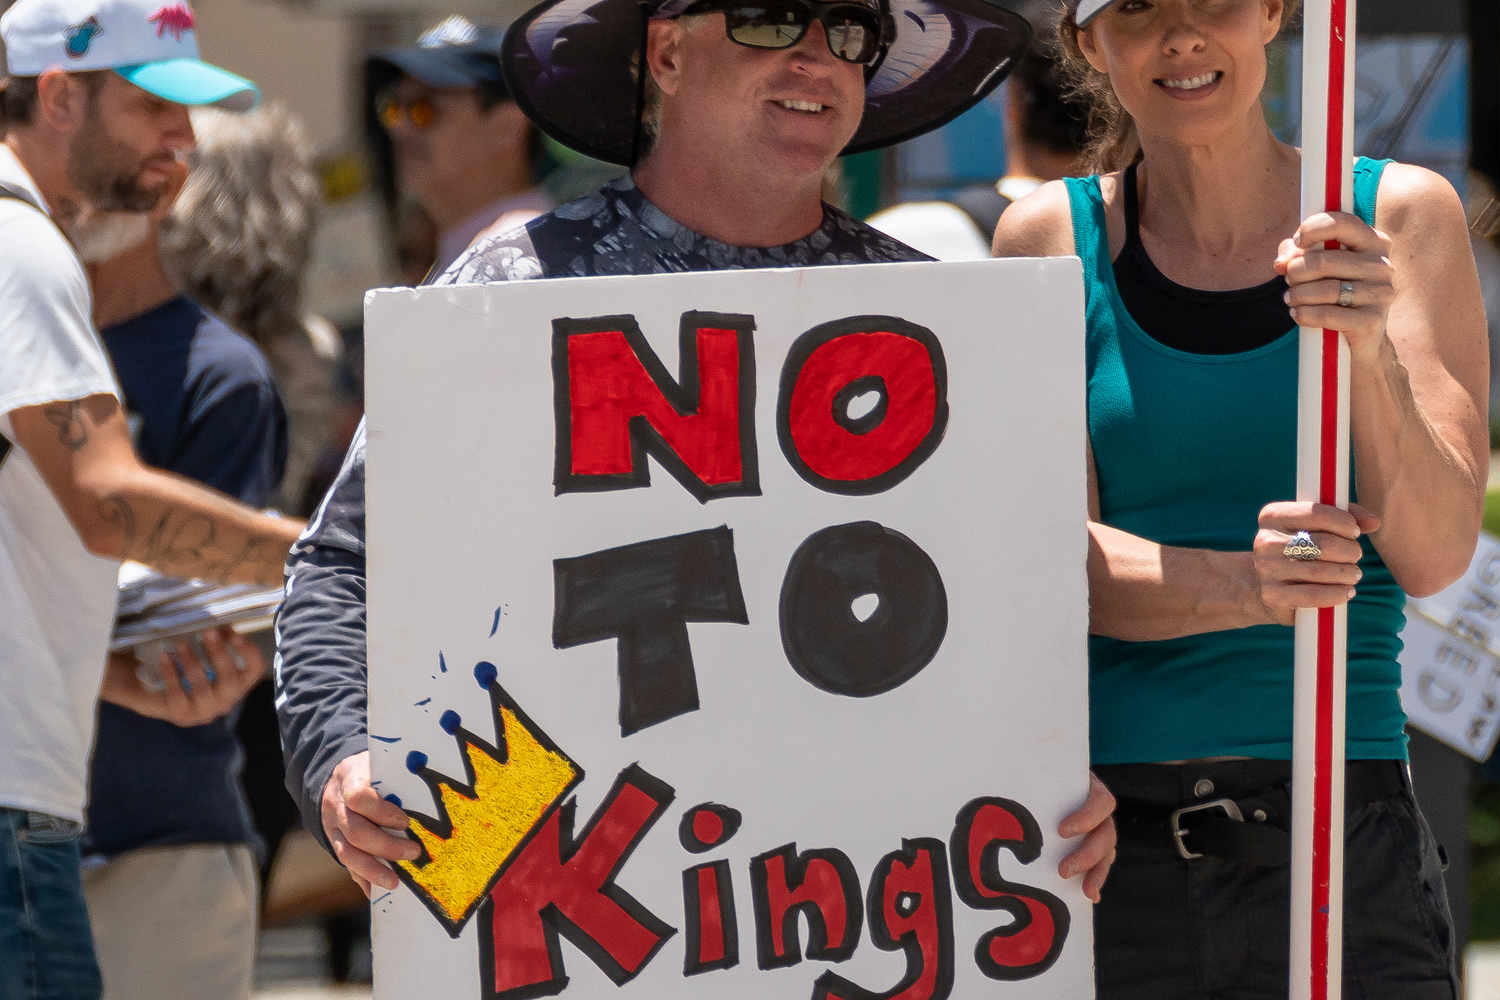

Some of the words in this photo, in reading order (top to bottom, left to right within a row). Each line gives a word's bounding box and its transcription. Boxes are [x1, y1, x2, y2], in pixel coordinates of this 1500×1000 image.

[551, 309, 950, 504] NO
[551, 521, 948, 738] TO
[476, 761, 1071, 1000] Kings
